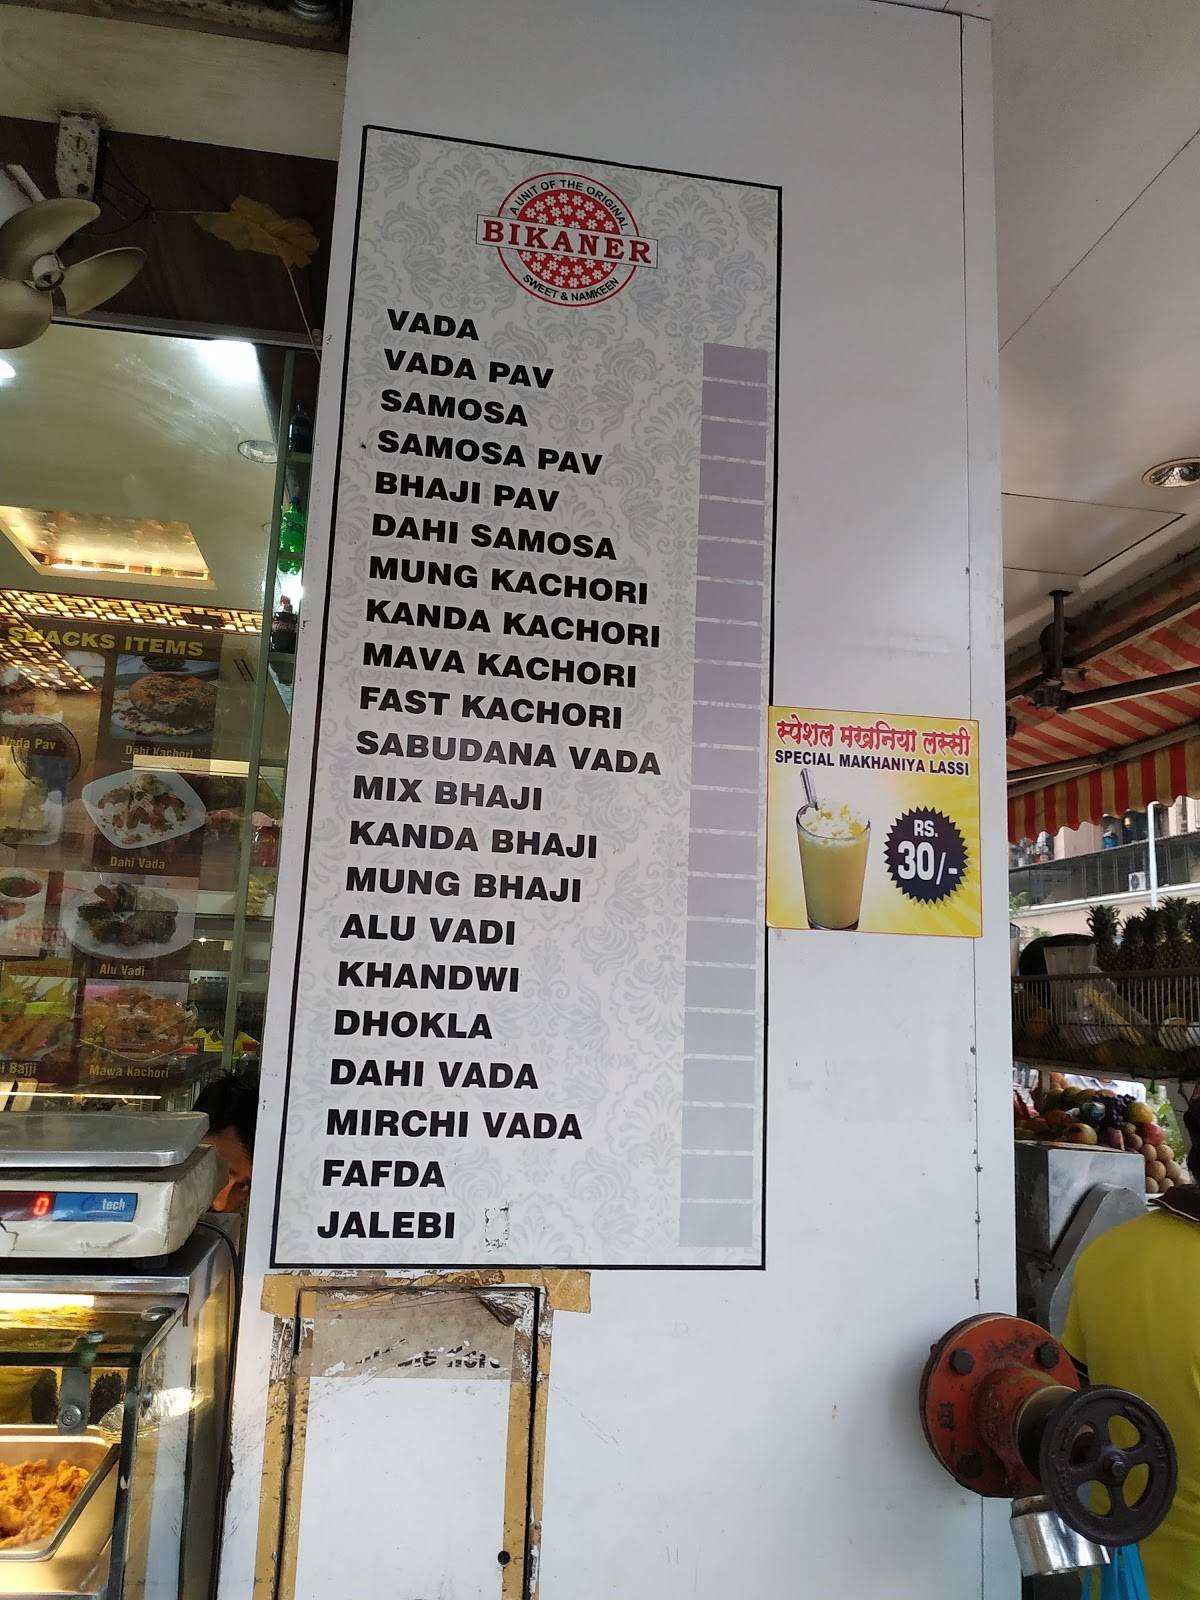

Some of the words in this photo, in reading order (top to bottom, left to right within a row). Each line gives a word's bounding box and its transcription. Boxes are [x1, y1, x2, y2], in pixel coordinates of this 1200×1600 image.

[509, 206, 519, 216] A
[516, 185, 539, 206] UNIT
[540, 179, 556, 191] OF
[560, 179, 584, 192] THE
[586, 186, 631, 231] ORIGINAL
[482, 219, 653, 265] BIKANER
[522, 274, 557, 299] SWEET
[559, 291, 569, 301] &
[571, 277, 620, 302] NAMKEEN
[386, 308, 480, 341] VADA
[383, 348, 477, 381] VADA
[488, 361, 555, 389] PAV
[380, 388, 528, 428] SAMOSA
[377, 429, 526, 468] SAMOSA
[537, 447, 603, 476] PAV
[375, 471, 481, 505] BHAJI
[493, 484, 560, 512] PAV
[372, 513, 459, 544] DAHI
[470, 523, 617, 561] SAMOSA
[369, 555, 478, 589] MUNG
[491, 567, 648, 605] KACHORI
[366, 598, 491, 633] KANDA
[503, 611, 660, 648] KACHORI
[124, 635, 204, 657] ITEMS
[362, 642, 466, 674] MAVA
[477, 652, 636, 688] KACHORI
[359, 685, 451, 716] FAST
[461, 694, 622, 730] KACHORI
[34, 738, 57, 751] Pav
[776, 714, 835, 747] स्पेशल
[840, 720, 917, 753] मखनिया
[922, 727, 971, 756] लस्सी
[356, 730, 557, 768] SABUDANA
[568, 746, 661, 776] VADA
[775, 749, 835, 767] SPECIAL
[839, 754, 926, 773] MAKHANIYA
[929, 760, 969, 776] LASSI
[353, 775, 423, 803] MIX
[435, 780, 542, 811] BHAJI
[349, 820, 479, 852] KANDA
[491, 829, 597, 859] BHAJI
[913, 819, 939, 838] RS.
[109, 855, 135, 869] Dahi
[138, 857, 166, 871] Vada
[897, 840, 958, 886] 30/-
[345, 866, 460, 897] MUNG
[473, 873, 581, 903] BHAJI
[339, 913, 416, 942] ALU
[429, 917, 515, 946] VADI
[99, 962, 118, 976] Alu
[121, 964, 146, 978] Vadi
[338, 961, 519, 993] KHANDWI
[334, 1009, 493, 1040] DHOKLA
[126, 1065, 169, 1079] Kachori
[330, 1058, 424, 1087] DAHI
[438, 1061, 538, 1090] VADA
[326, 1108, 469, 1138] MIRCHI
[482, 1111, 583, 1140] VADA
[322, 1159, 446, 1188] FAFDA
[33, 1197, 50, 1216] 0
[317, 1211, 455, 1239] JALEBI
